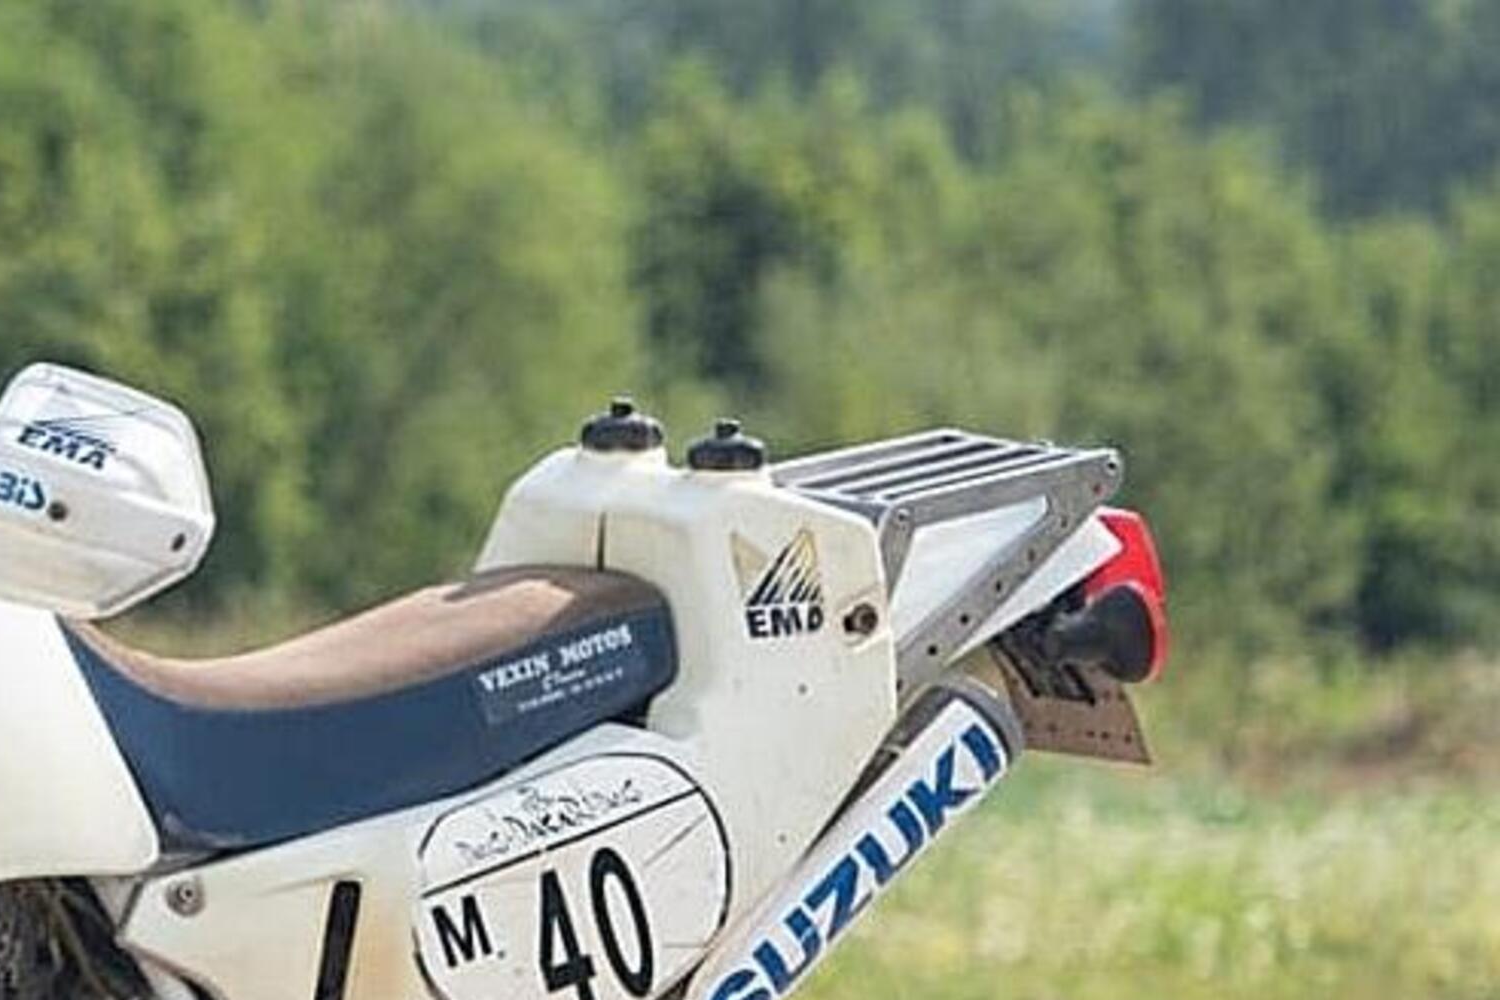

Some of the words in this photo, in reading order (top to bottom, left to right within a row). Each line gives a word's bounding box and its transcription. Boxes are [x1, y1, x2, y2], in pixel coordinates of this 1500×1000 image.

[17, 424, 107, 470] EMA
[479, 653, 551, 693] VEXIN
[558, 624, 632, 666] MOTOS
